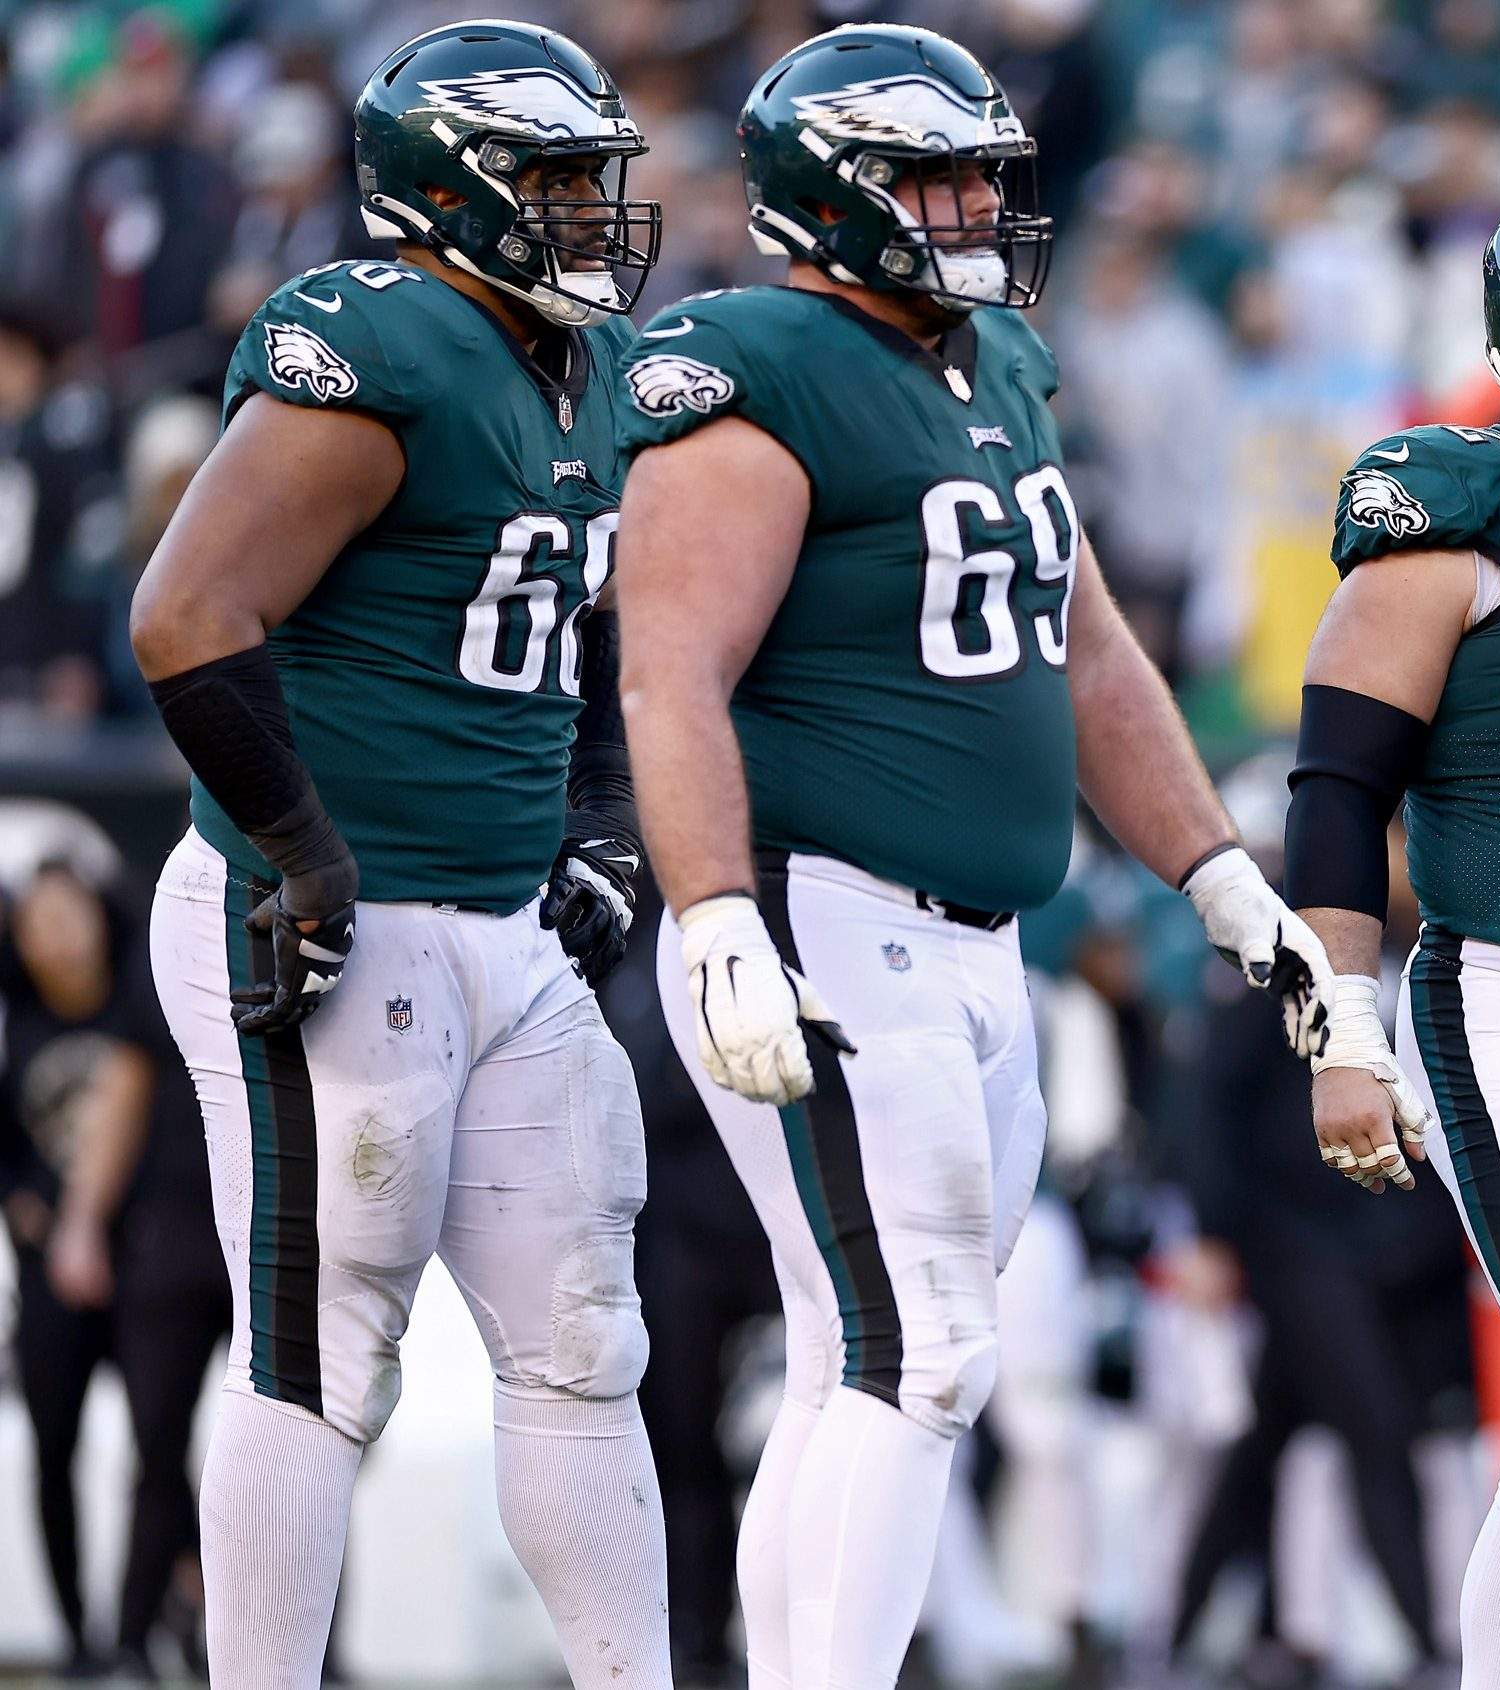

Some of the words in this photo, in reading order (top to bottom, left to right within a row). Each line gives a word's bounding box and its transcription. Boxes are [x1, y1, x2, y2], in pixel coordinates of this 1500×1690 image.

[551, 459, 587, 485] EAGLES
[918, 464, 1079, 678] 69
[391, 1011, 411, 1027] NFL
